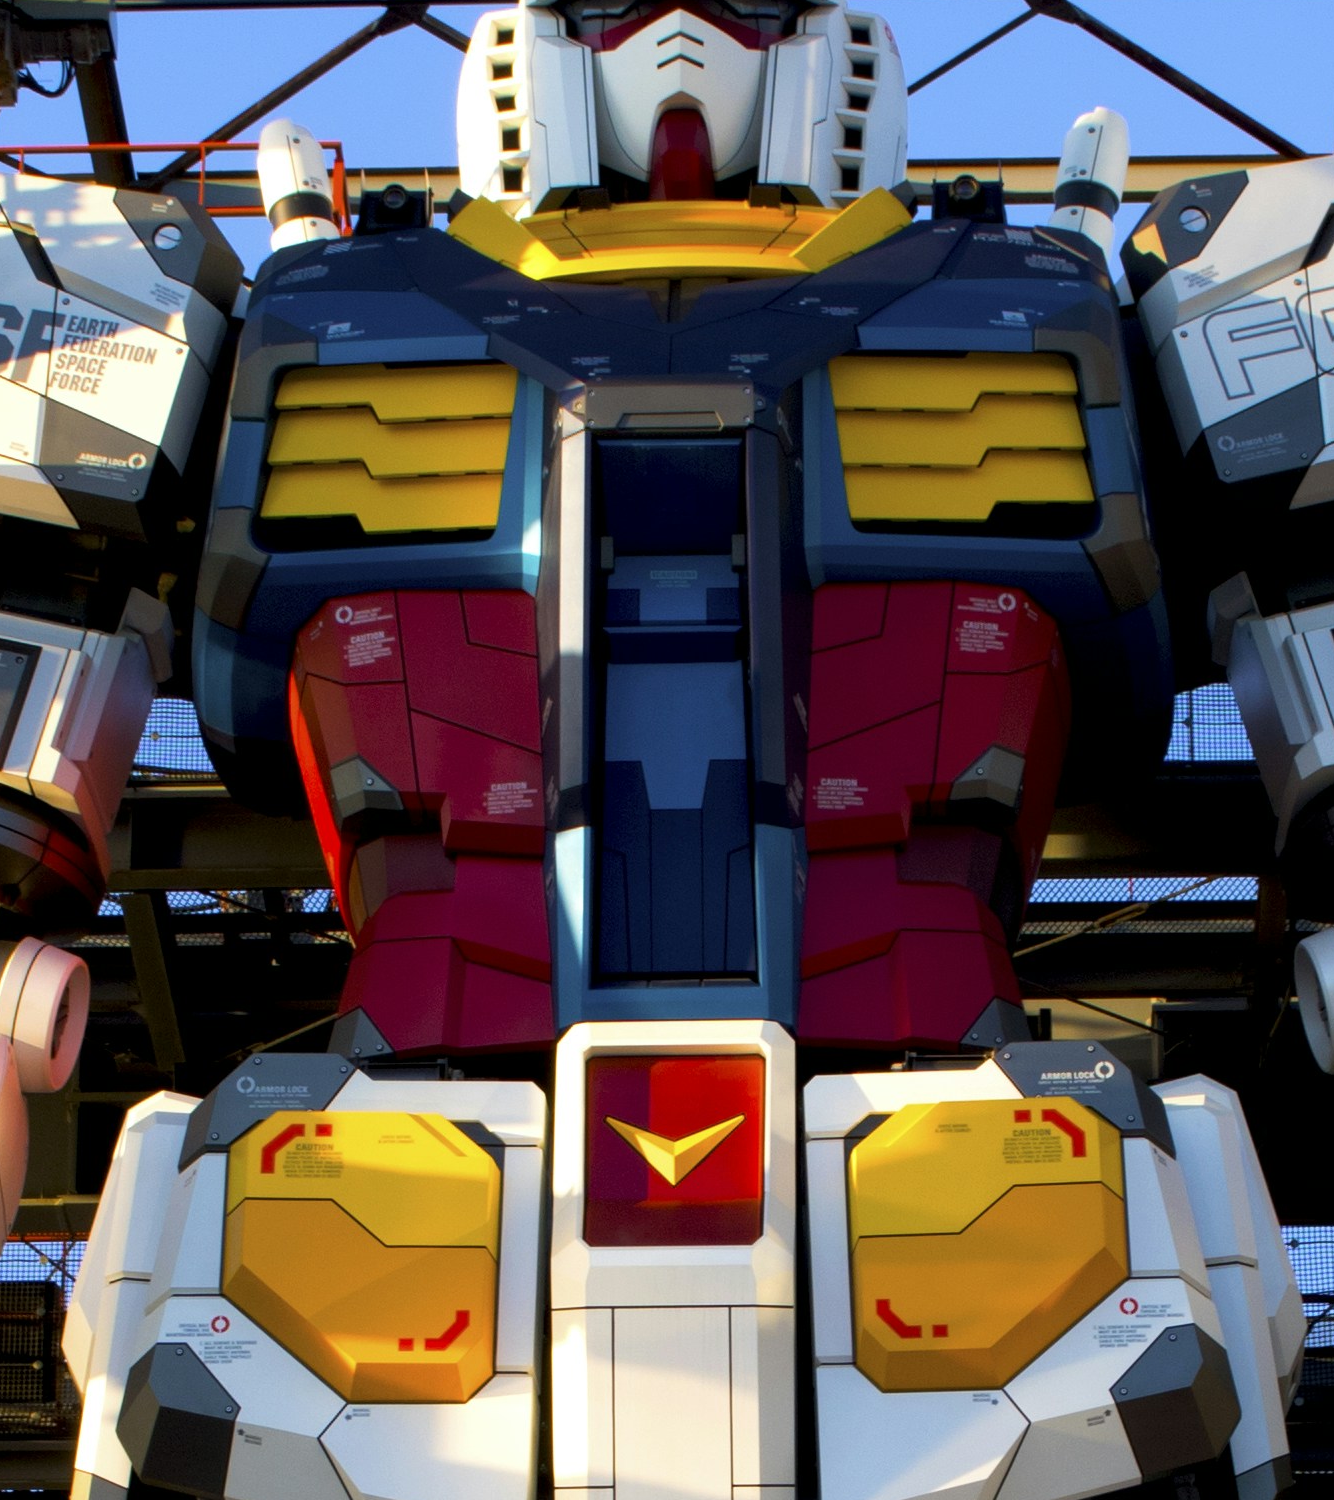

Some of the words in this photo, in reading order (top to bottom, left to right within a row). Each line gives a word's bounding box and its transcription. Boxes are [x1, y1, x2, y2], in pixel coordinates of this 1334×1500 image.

[66, 315, 119, 338] EARTH
[61, 334, 157, 366] FEDERATION
[55, 352, 107, 376] SPACE
[49, 371, 102, 395] FORCE
[963, 620, 999, 631] CAUTION
[350, 631, 385, 644] CAUTION
[491, 782, 527, 791] CAUTION
[820, 778, 858, 787] CAUTION
[1040, 1072, 1072, 1080] ARMOR
[1073, 1071, 1095, 1080] LOCK
[287, 1085, 308, 1093] LOCK
[1012, 1128, 1051, 1137] CAUTION
[295, 1143, 334, 1151] CAUTION
